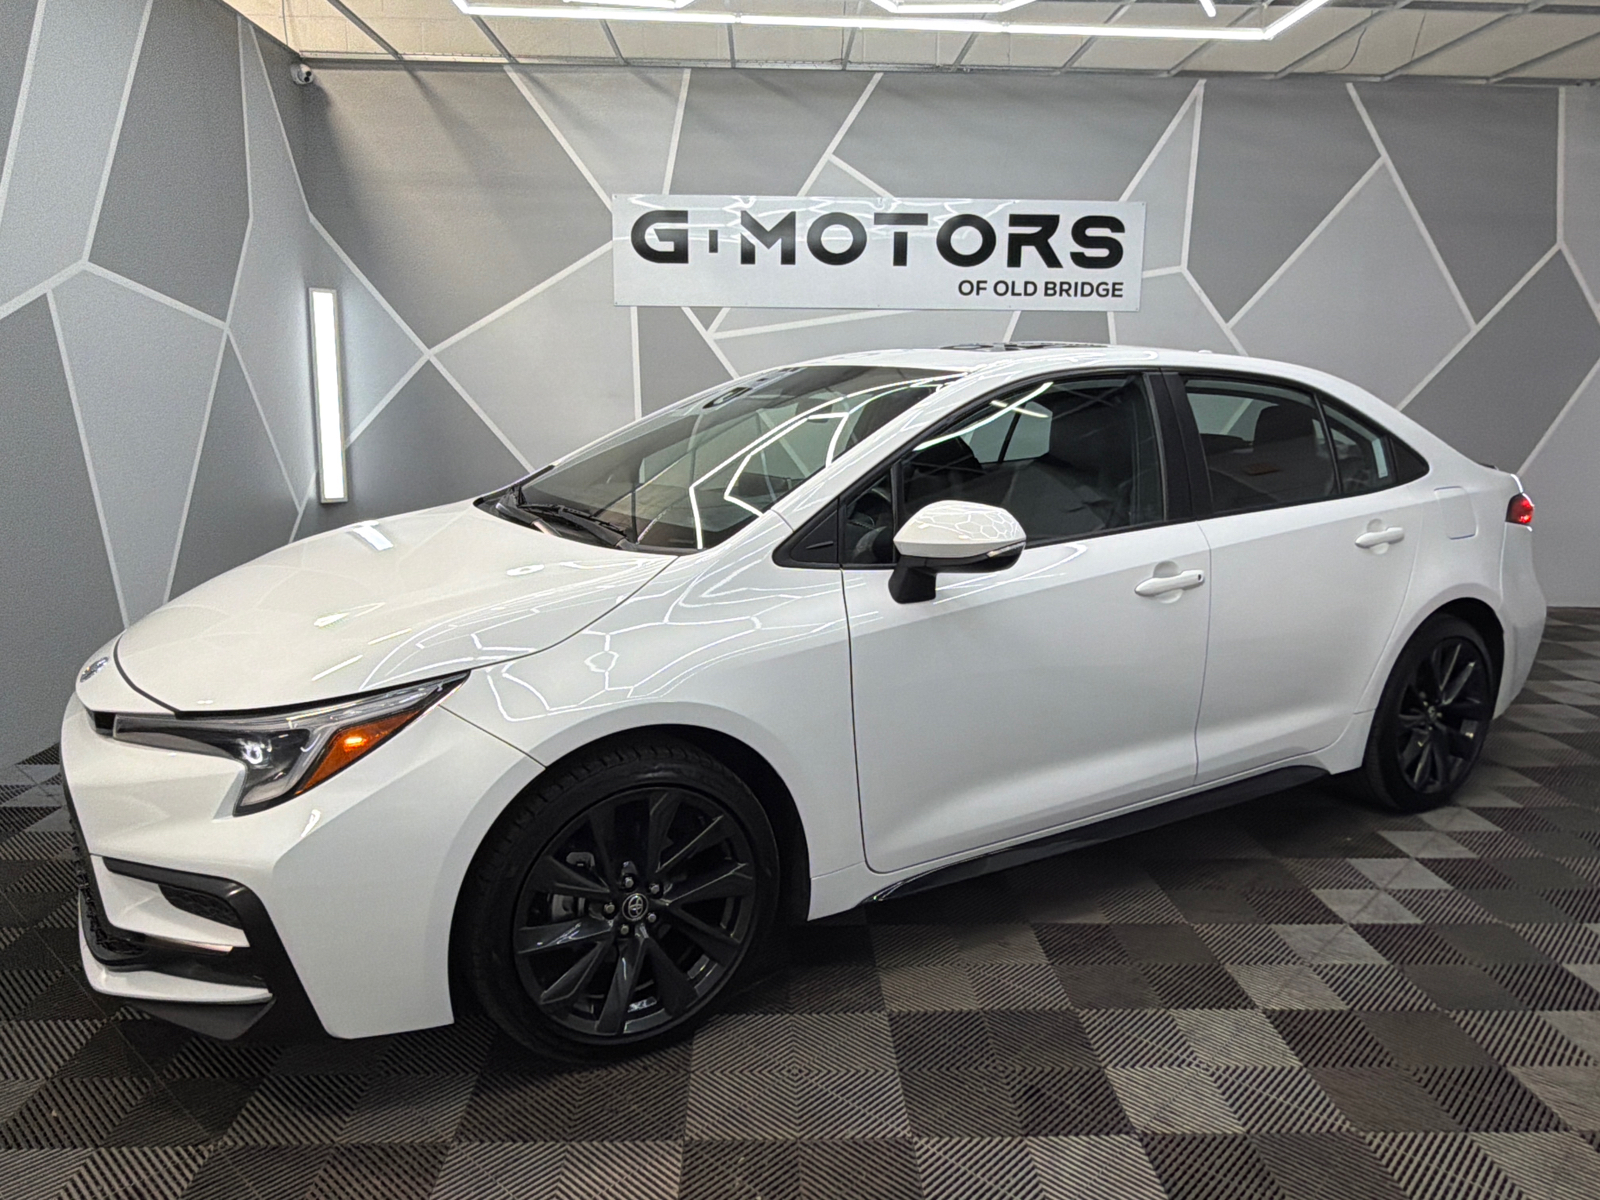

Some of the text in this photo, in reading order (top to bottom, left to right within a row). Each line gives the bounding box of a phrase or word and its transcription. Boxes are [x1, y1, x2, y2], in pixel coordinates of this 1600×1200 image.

[957, 279, 1125, 299] OF OLD BRIDGE
